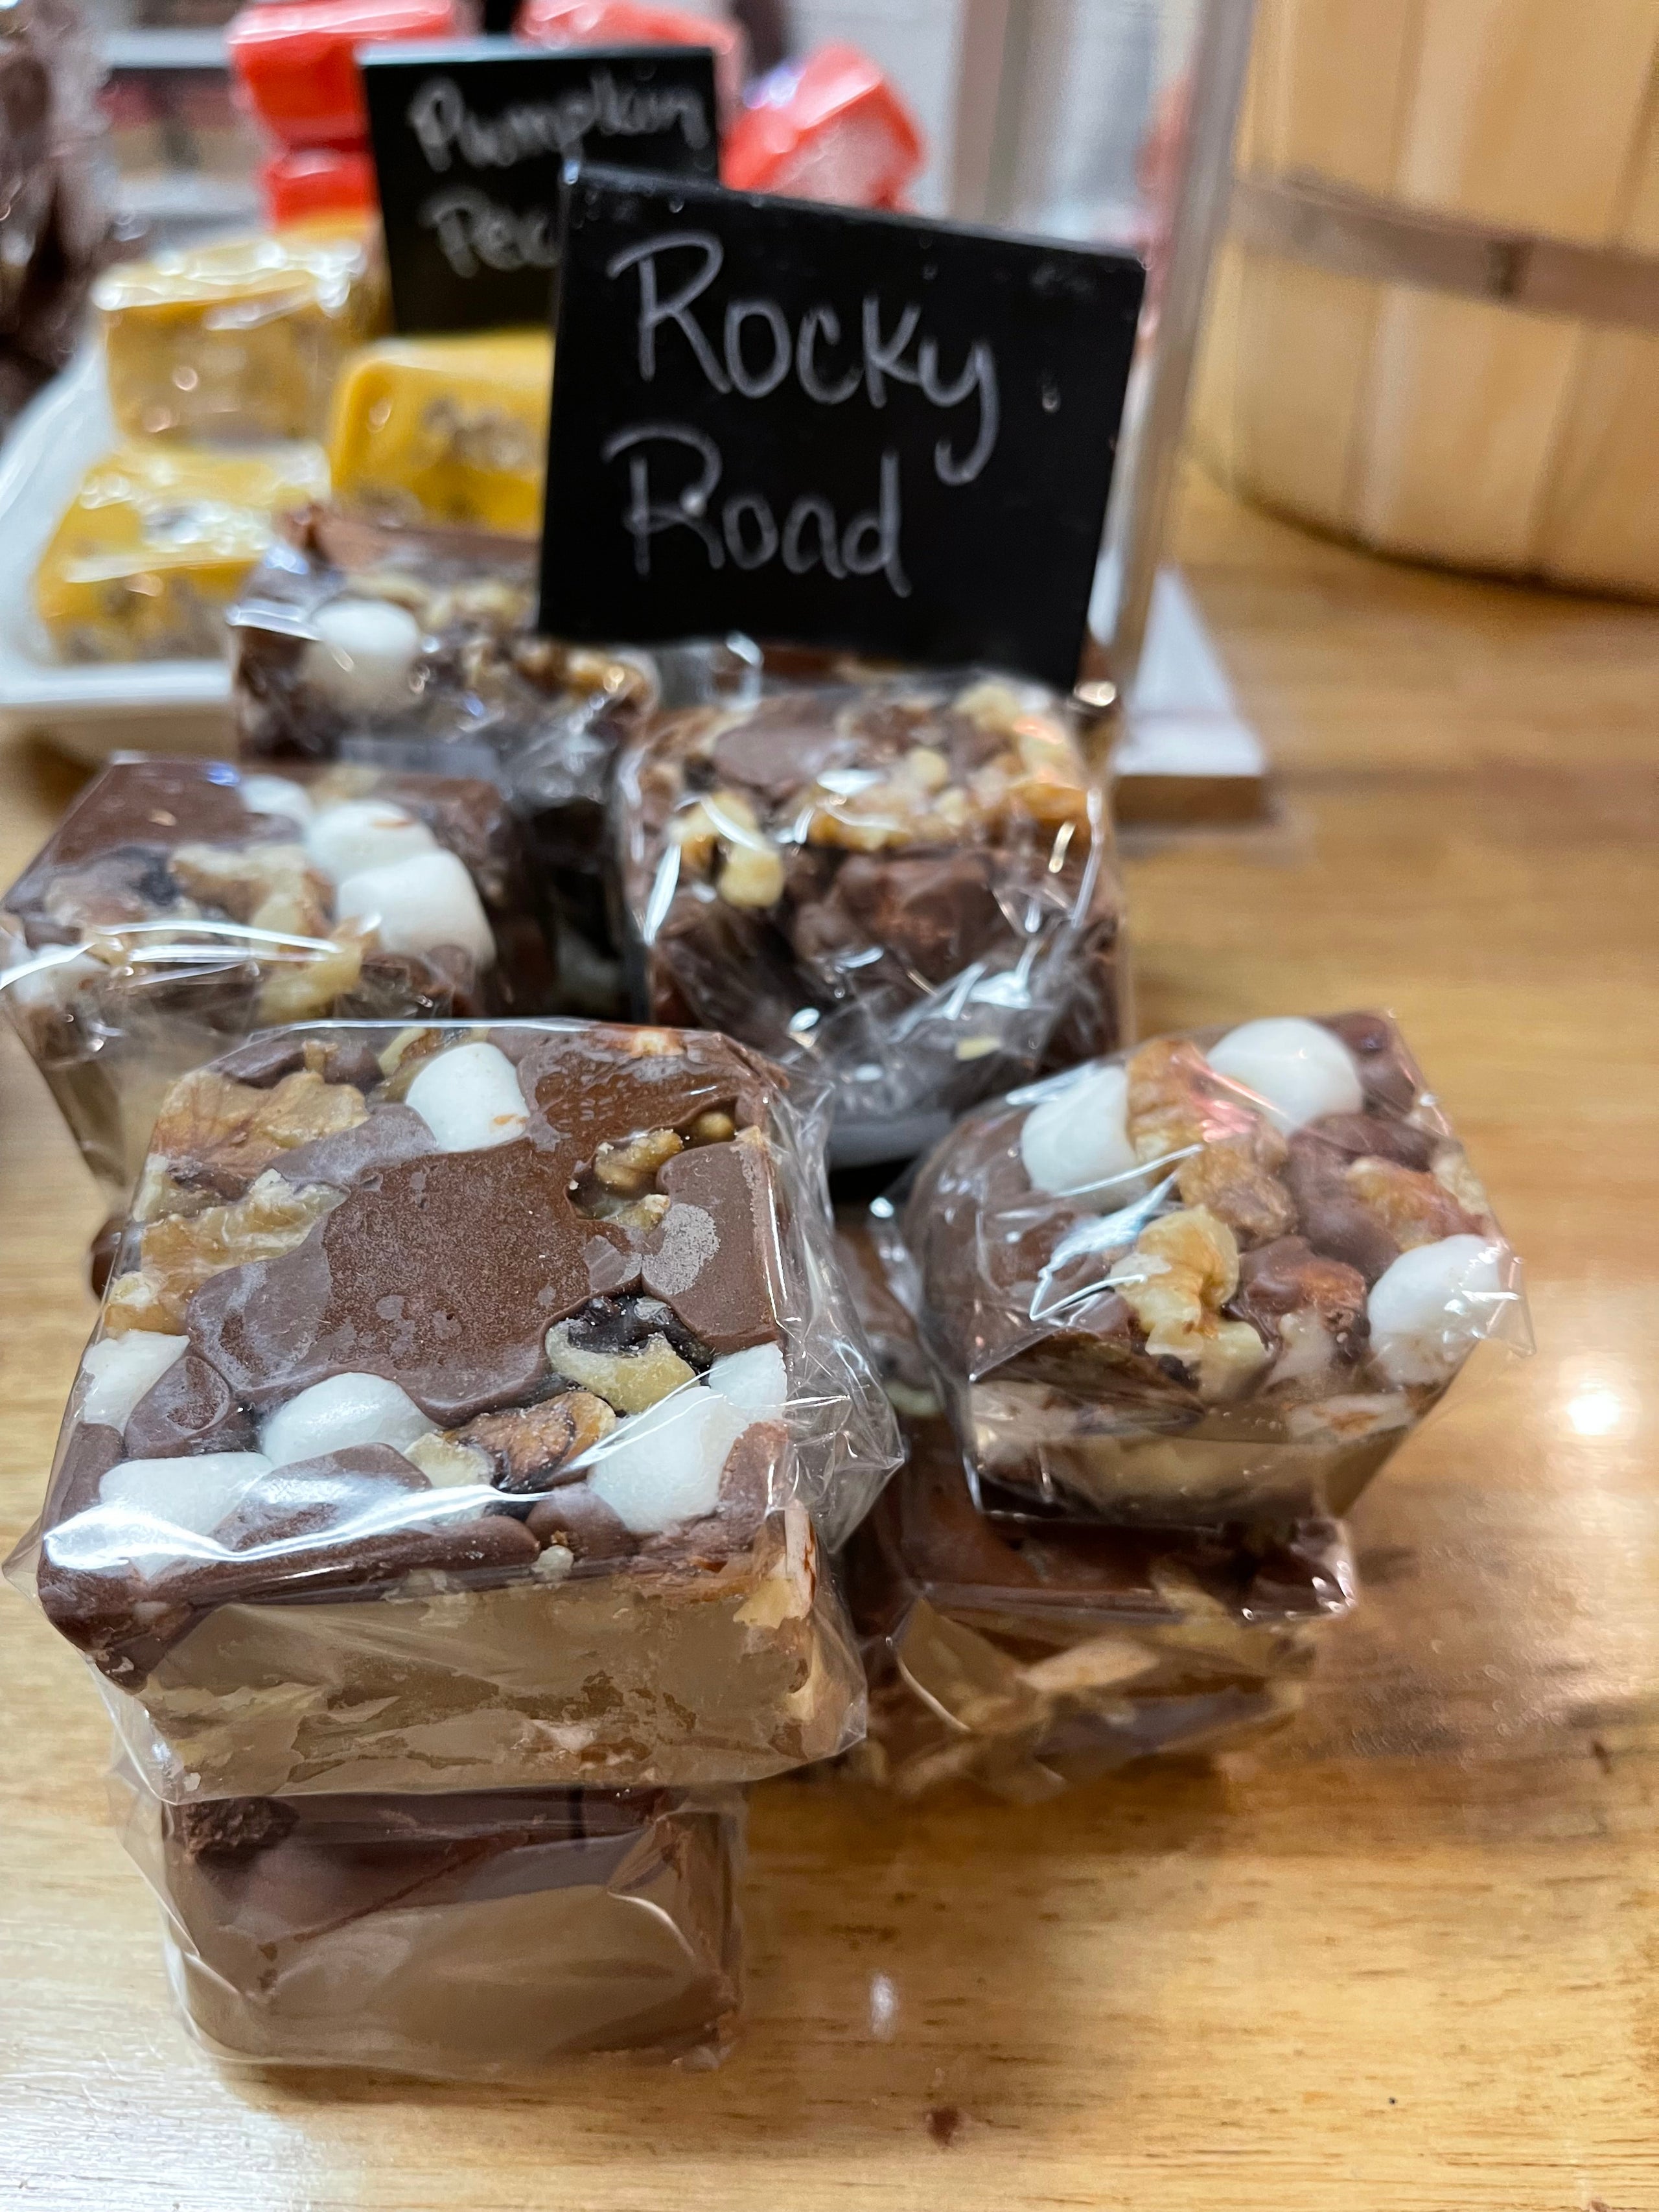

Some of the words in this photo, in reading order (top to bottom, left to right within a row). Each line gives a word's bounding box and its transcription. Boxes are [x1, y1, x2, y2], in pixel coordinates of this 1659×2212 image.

[410, 69, 708, 171] Pumpkin
[607, 231, 999, 486] Rocky
[602, 424, 911, 598] Road
